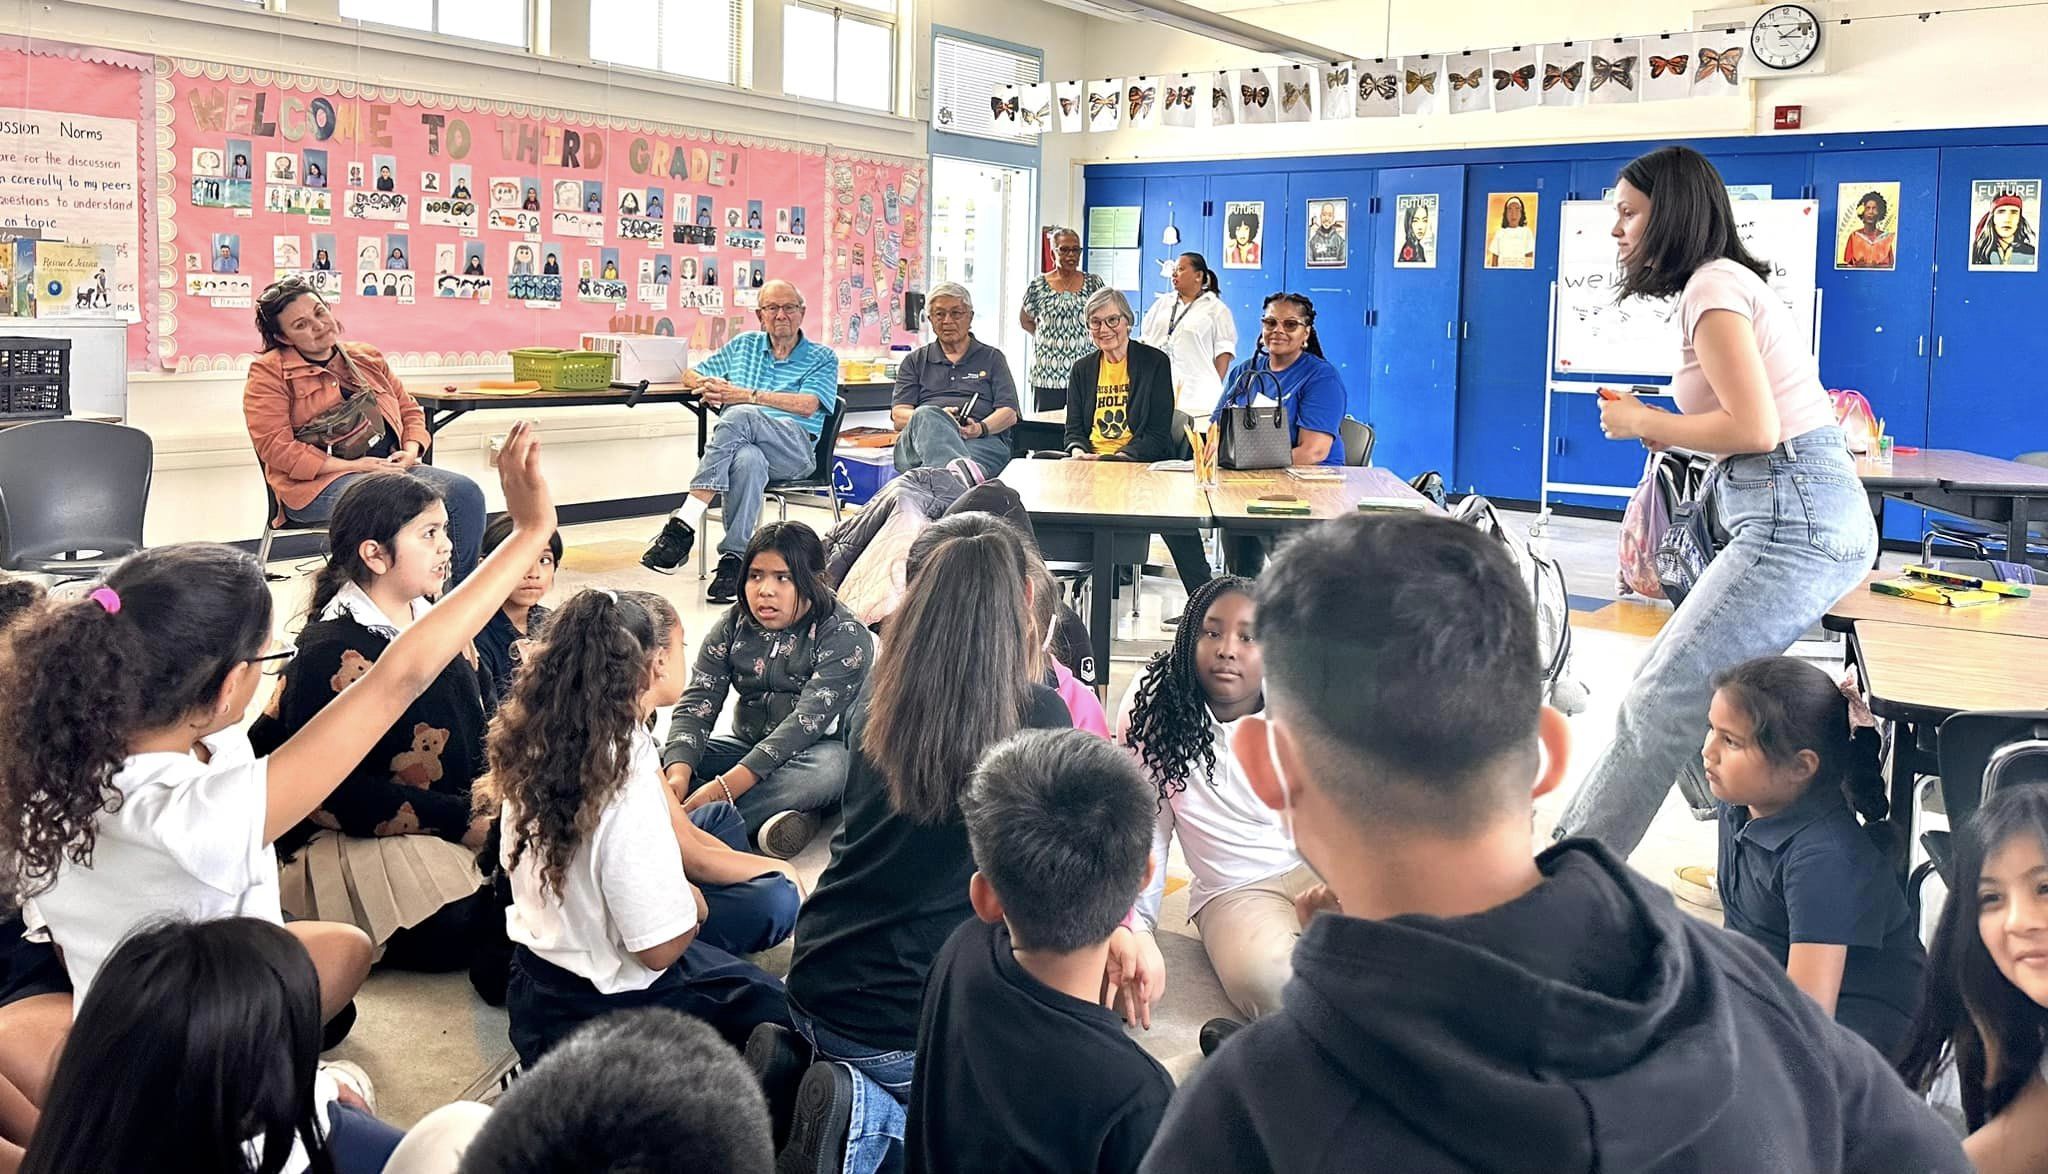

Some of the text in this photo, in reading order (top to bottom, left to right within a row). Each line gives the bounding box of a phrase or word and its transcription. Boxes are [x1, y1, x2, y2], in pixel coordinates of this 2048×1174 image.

[60, 121, 103, 141] Norms
[187, 87, 739, 187] WELCOME TO THIRD GRADE!
[24, 154, 39, 165] for
[46, 151, 62, 166] the
[68, 155, 121, 169] discussion
[69, 174, 79, 188] to
[84, 180, 98, 191] my
[102, 182, 132, 192] peers
[1978, 185, 2035, 197] FUTURE
[57, 195, 69, 208] to
[73, 198, 134, 212] understand
[1229, 204, 1260, 215] FUTURE
[1400, 198, 1437, 209] FUTURE
[4, 213, 57, 229] on topic
[690, 316, 745, 350] ARE
